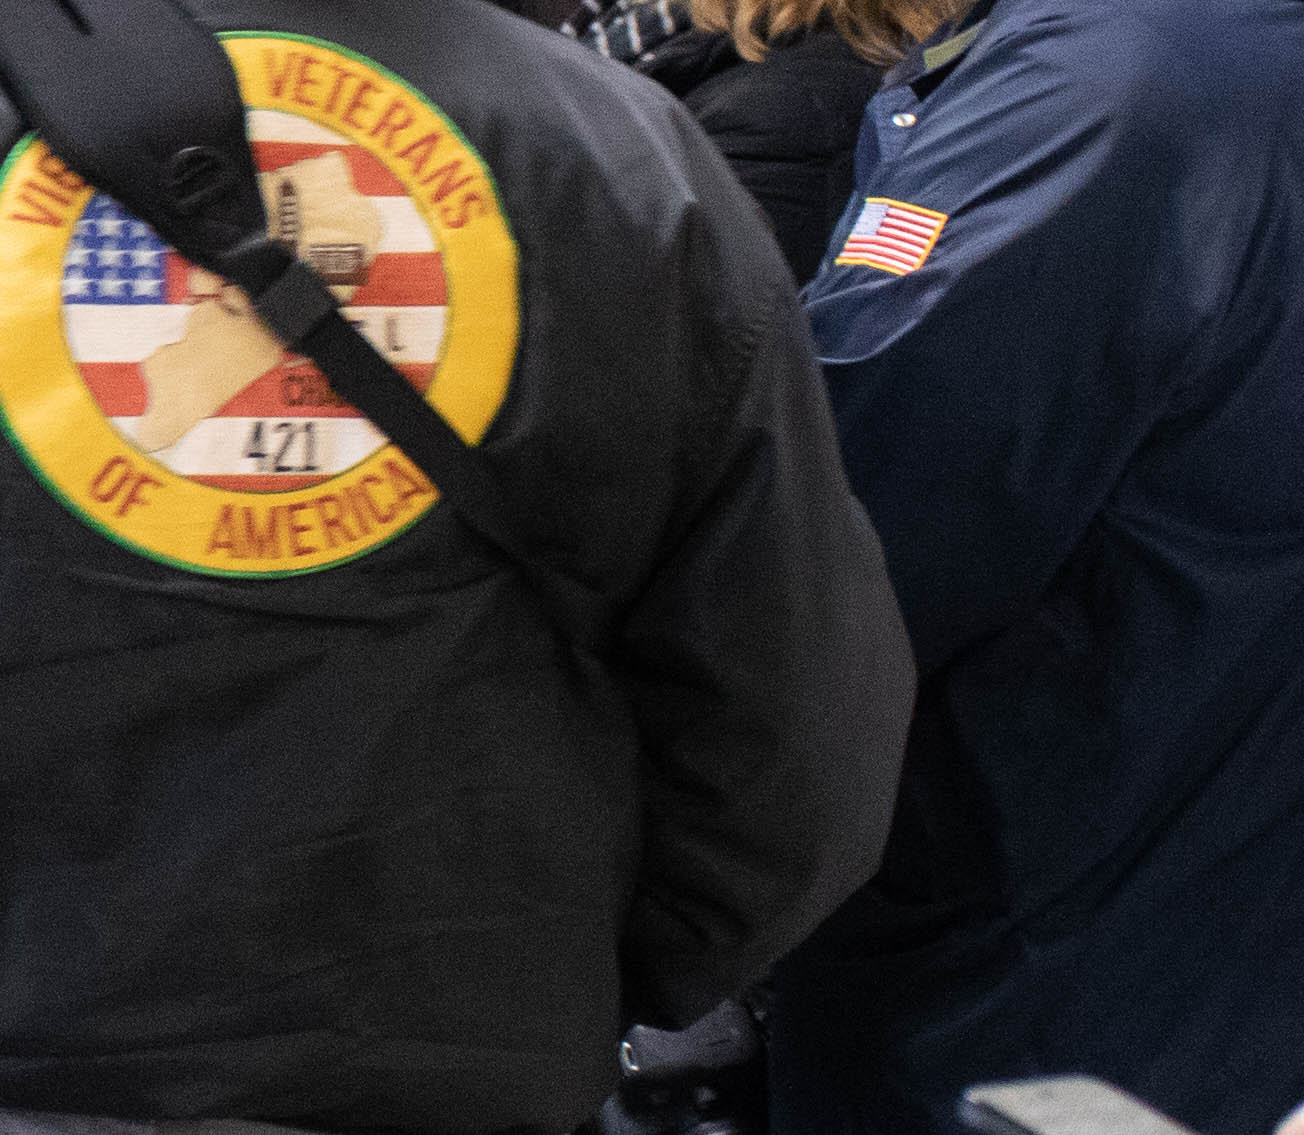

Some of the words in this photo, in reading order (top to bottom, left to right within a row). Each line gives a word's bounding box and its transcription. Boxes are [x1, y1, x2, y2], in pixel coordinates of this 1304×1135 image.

[260, 48, 490, 231] VETERANS
[246, 421, 319, 473] 421
[87, 455, 169, 519] OF
[204, 458, 433, 561] AMERICA
